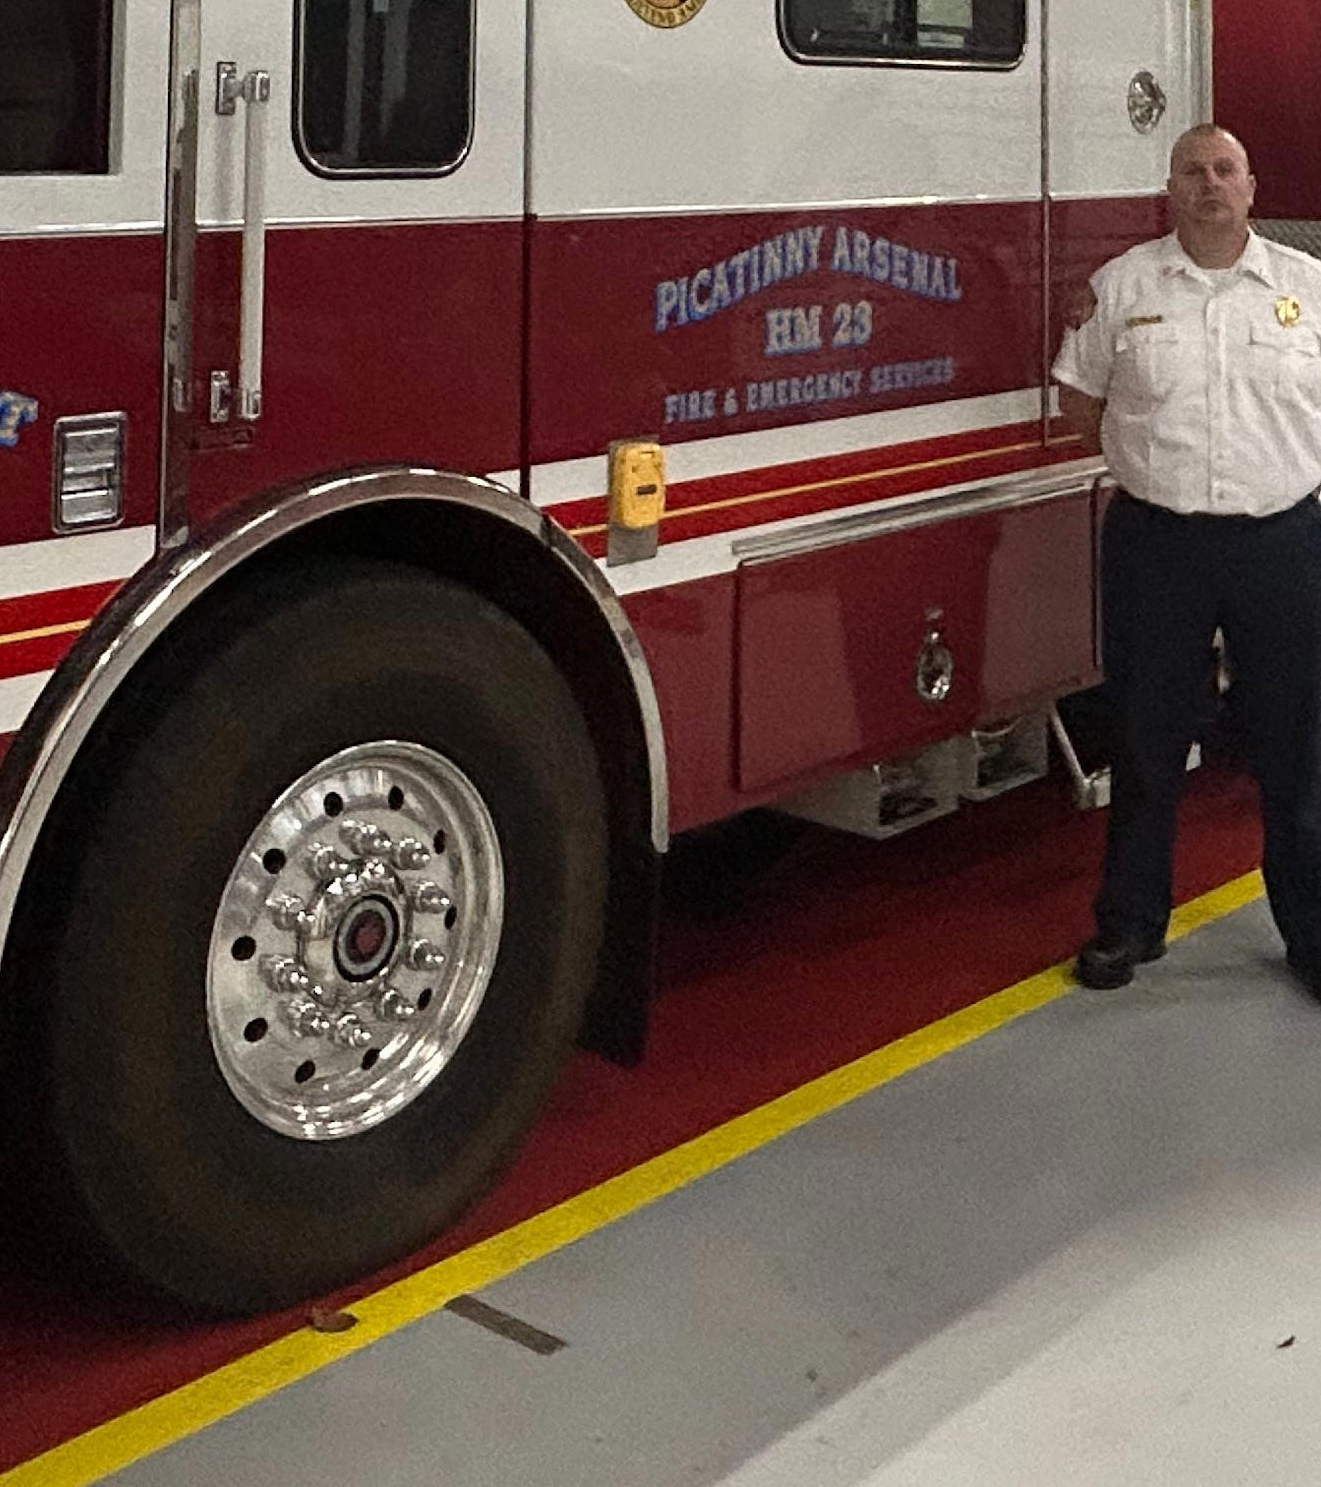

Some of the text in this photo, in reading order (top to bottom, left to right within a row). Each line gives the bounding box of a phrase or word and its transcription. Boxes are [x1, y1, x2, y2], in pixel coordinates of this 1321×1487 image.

[654, 225, 963, 332] PICATINNY ARSENAL
[764, 300, 874, 355] HM 23
[663, 356, 955, 425] FIRE & EMERGENCY SERVICES
